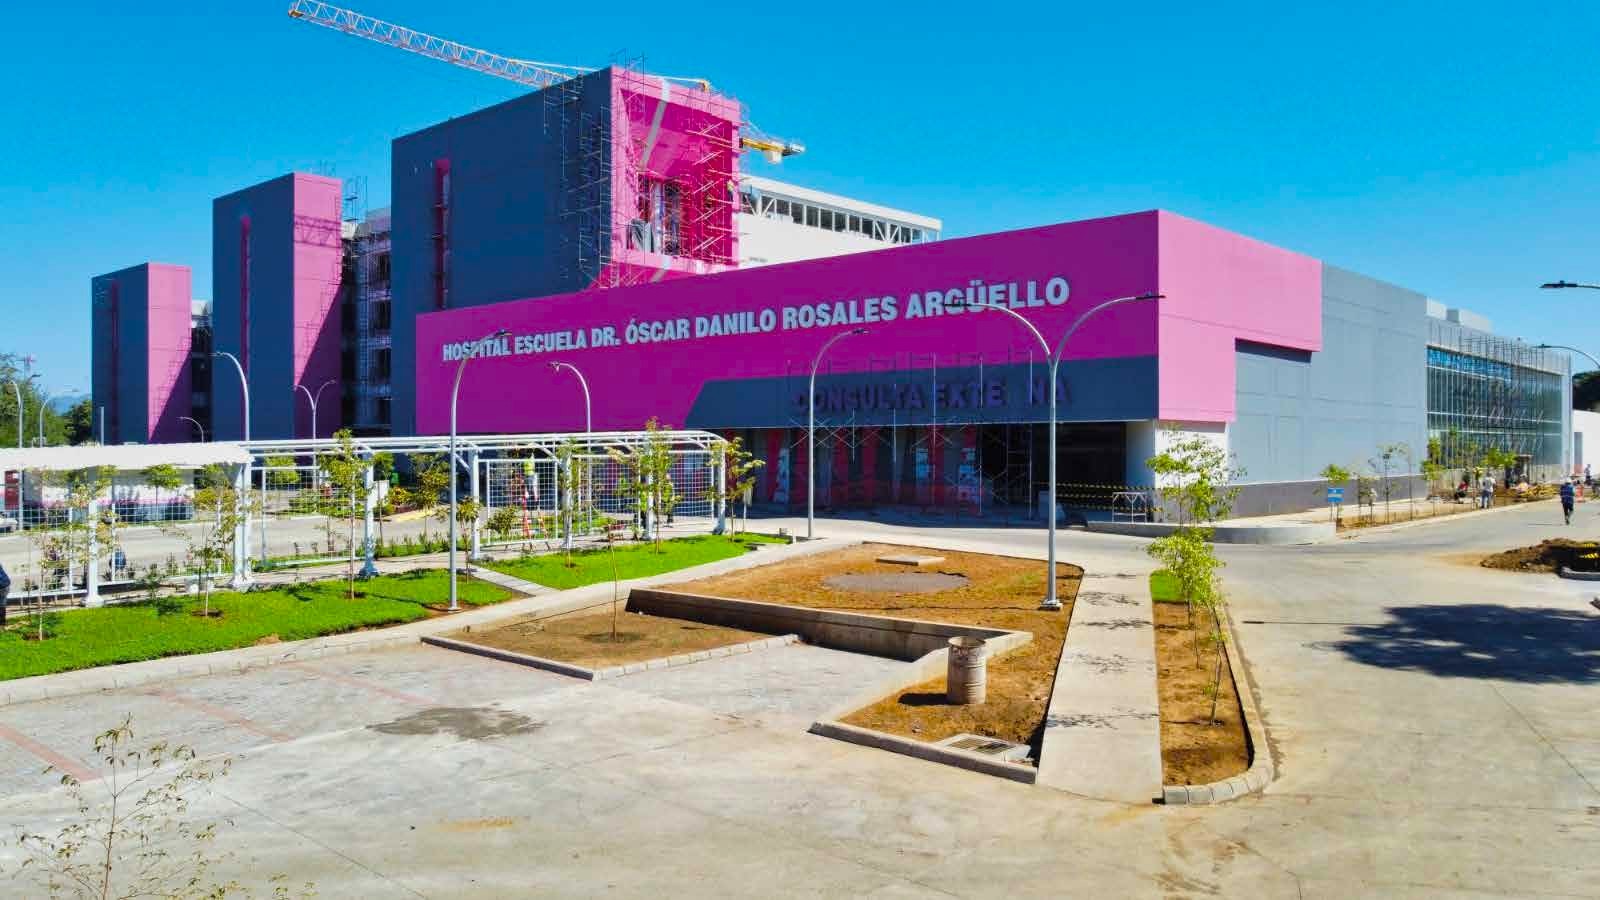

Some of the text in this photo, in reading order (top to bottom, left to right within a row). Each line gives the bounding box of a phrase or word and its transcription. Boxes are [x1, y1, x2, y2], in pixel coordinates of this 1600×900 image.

[443, 276, 1070, 361] HOSPITAL ESCUELA DR. ÓSCAR DANILO ROSALES ARGÜELLO
[793, 383, 926, 416] CONSULTA
